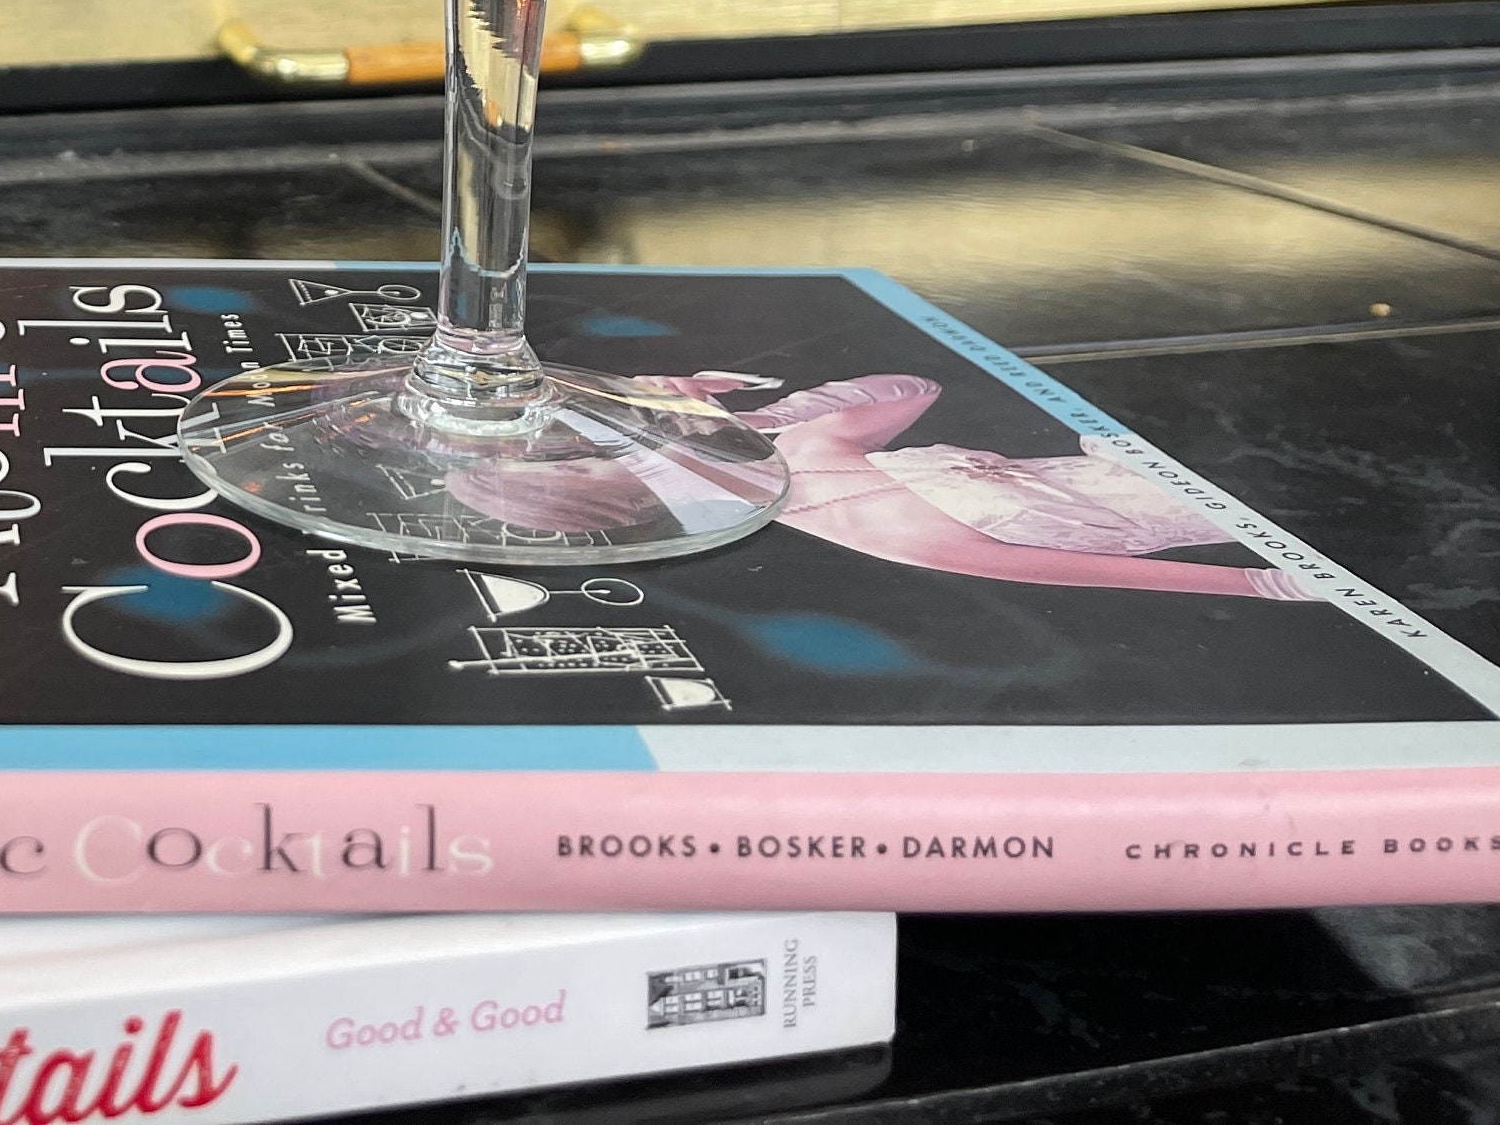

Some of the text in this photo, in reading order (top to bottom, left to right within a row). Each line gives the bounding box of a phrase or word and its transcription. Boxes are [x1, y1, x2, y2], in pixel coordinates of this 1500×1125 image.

[220, 313, 254, 354] Times
[259, 421, 295, 452] for
[16, 283, 295, 681] Cocktails
[275, 462, 332, 531] rinks
[1143, 460, 1228, 511] GIDEON
[1235, 516, 1337, 580] BROOKS,
[305, 548, 378, 624] Mixed
[1334, 586, 1428, 639] KAREN
[72, 800, 495, 883] Cocktails
[556, 833, 1055, 859] BROOKS BOSKER DARMON
[1124, 834, 1500, 860] CHRONICLE BOOKS
[782, 938, 801, 1030] RUNNING
[802, 954, 819, 1009] PRESS
[324, 988, 568, 1052] Good & Good
